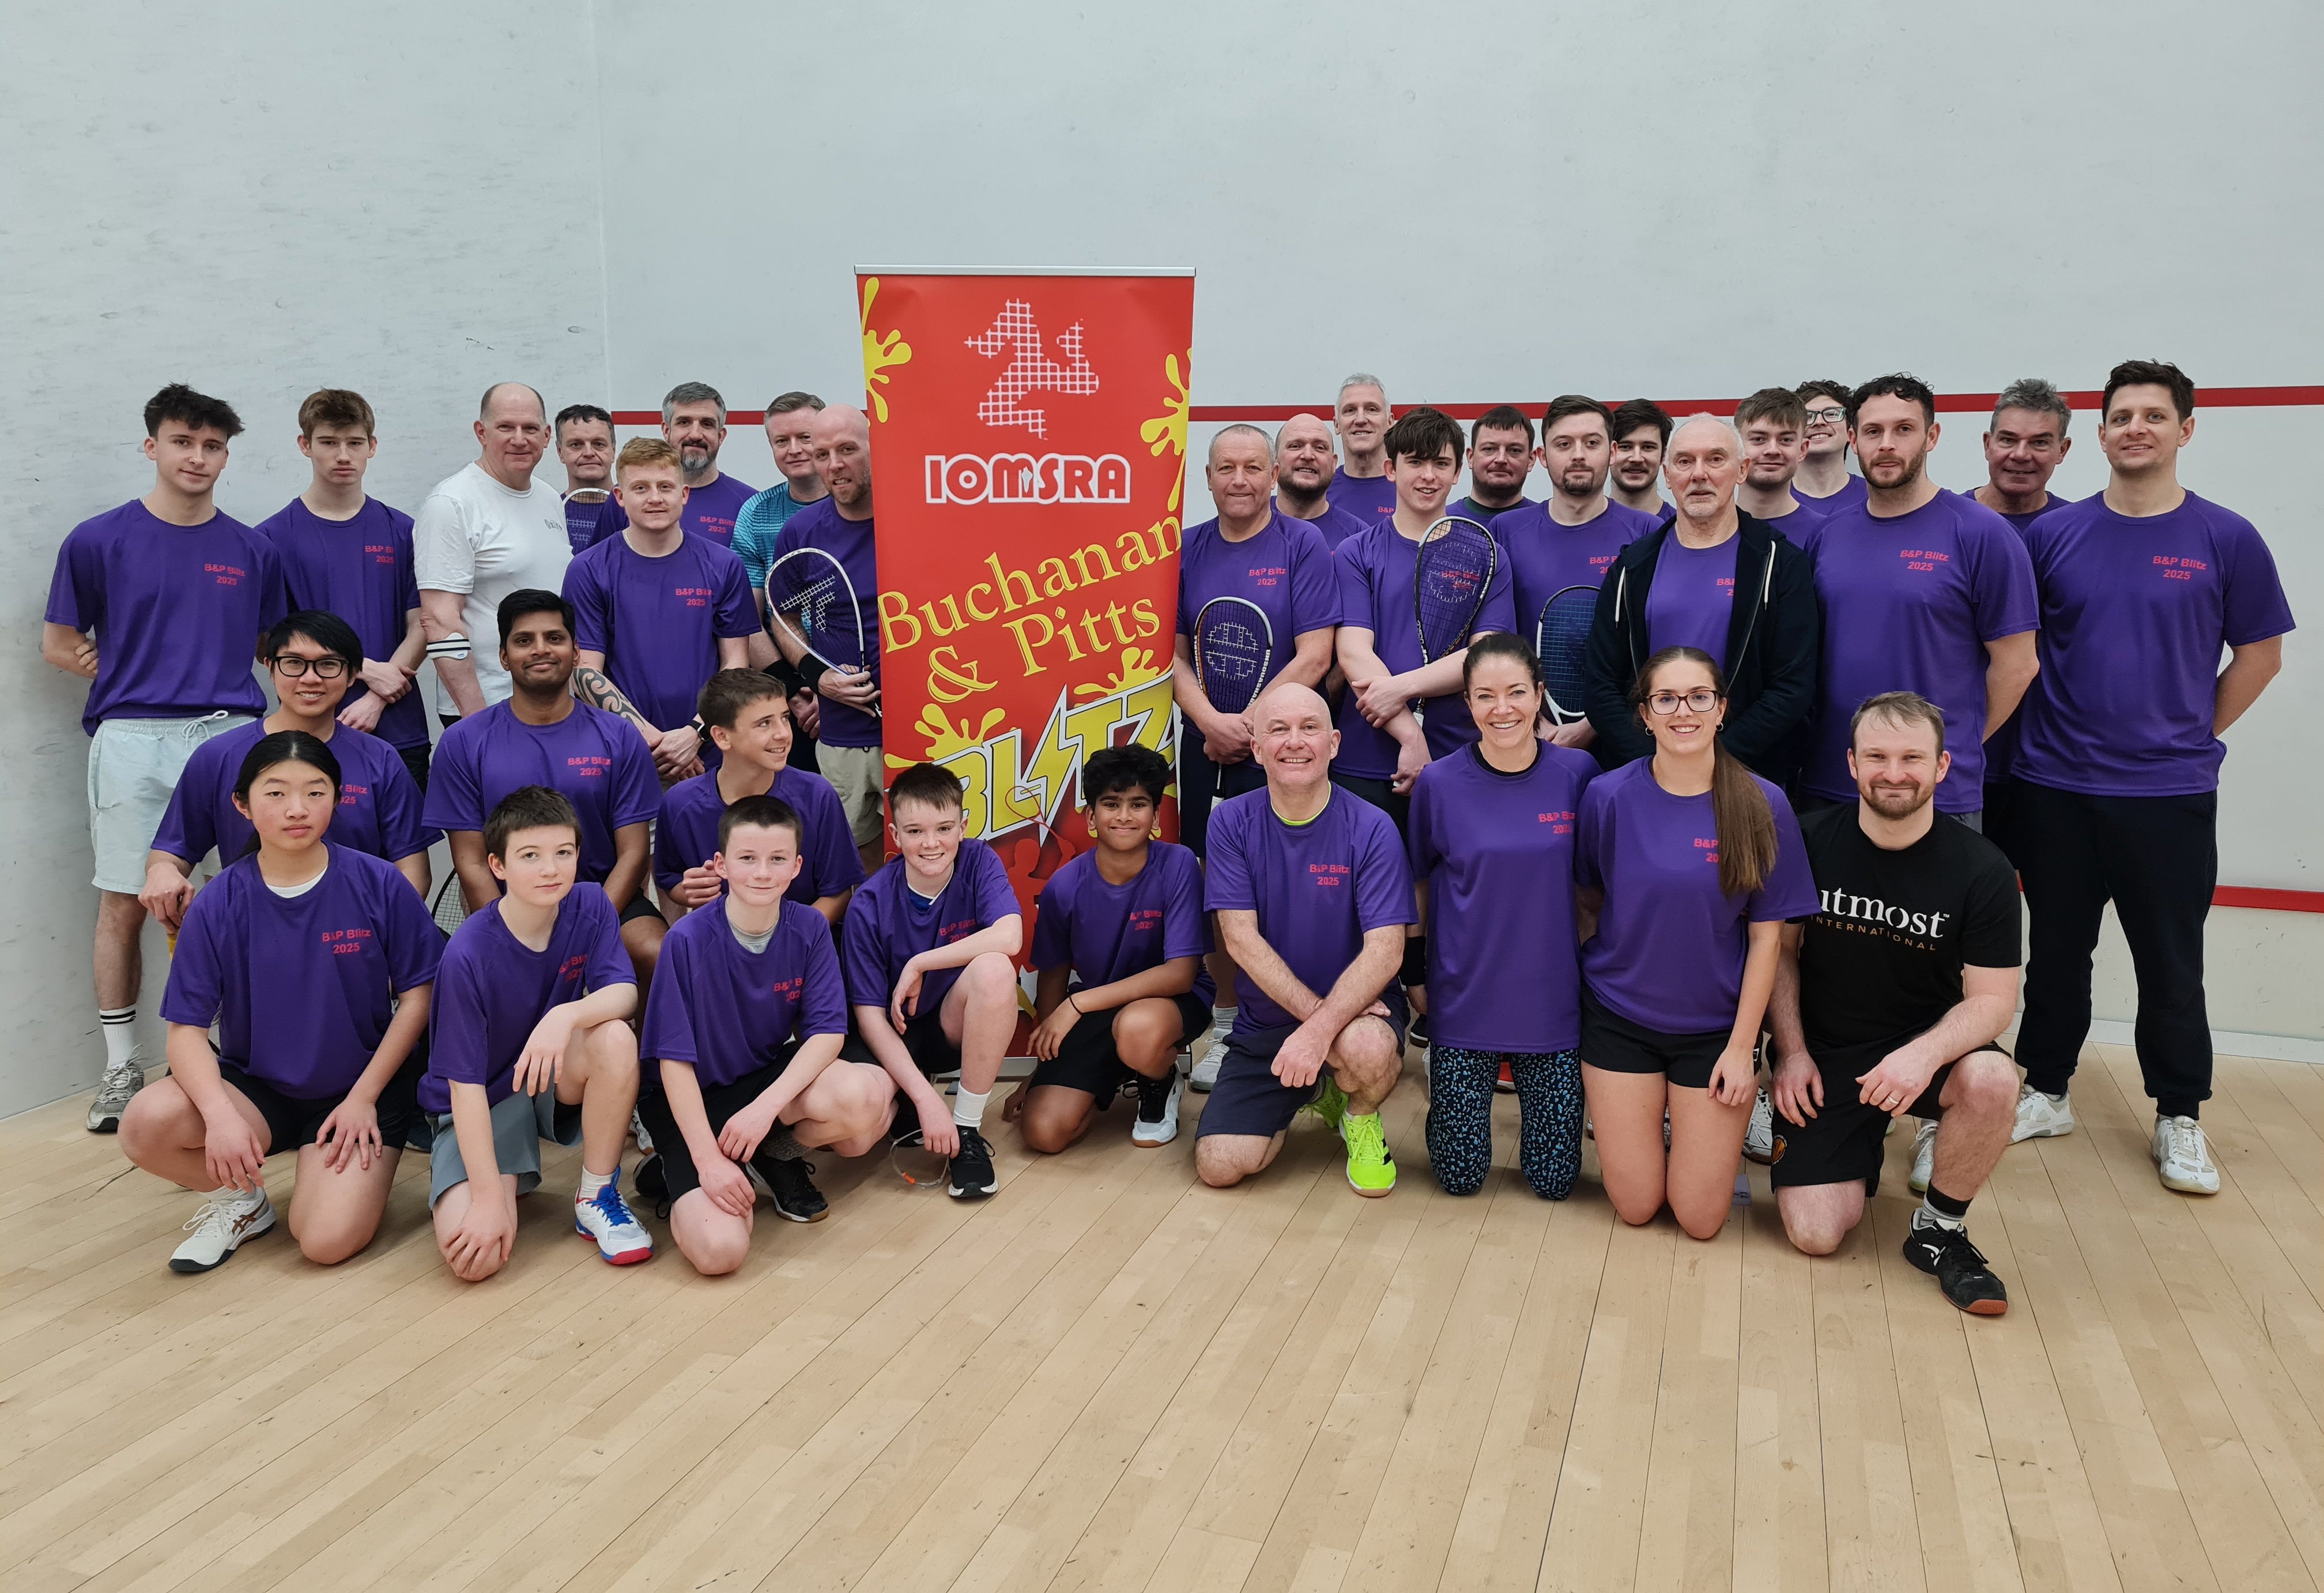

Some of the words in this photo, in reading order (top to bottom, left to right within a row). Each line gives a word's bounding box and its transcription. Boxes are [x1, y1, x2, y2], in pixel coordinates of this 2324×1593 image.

[925, 453, 1131, 505] IOMSRA
[1590, 556, 1609, 564] B&P
[1900, 550, 1923, 558] B&P
[1924, 551, 1949, 562] Blitz
[1907, 562, 1934, 571] 2025
[2153, 555, 2179, 565] B&P
[2180, 558, 2207, 570] Blitz
[205, 564, 225, 572] B&P
[228, 566, 246, 576] Blitz
[1249, 567, 1267, 575] B&P
[1267, 567, 1286, 575] Blitz
[2163, 569, 2191, 580] 2025
[217, 575, 237, 585] 2025
[877, 515, 1182, 654] Buchanan
[1257, 578, 1277, 586] 2025
[676, 588, 694, 596] B&P
[927, 645, 998, 703] &
[1002, 598, 1160, 677] Pitts
[568, 757, 588, 765] B&P
[580, 767, 602, 775] 2025
[340, 796, 356, 804] 25
[1538, 812, 1559, 822] B&P
[1694, 838, 1719, 848] B&P
[1706, 853, 1719, 863] 20
[1329, 865, 1350, 873] Blitz
[1318, 876, 1340, 886] 2025
[346, 928, 371, 939] Blitz
[1810, 914, 1936, 951] INTERNATIONAL
[333, 942, 360, 954] 2025
